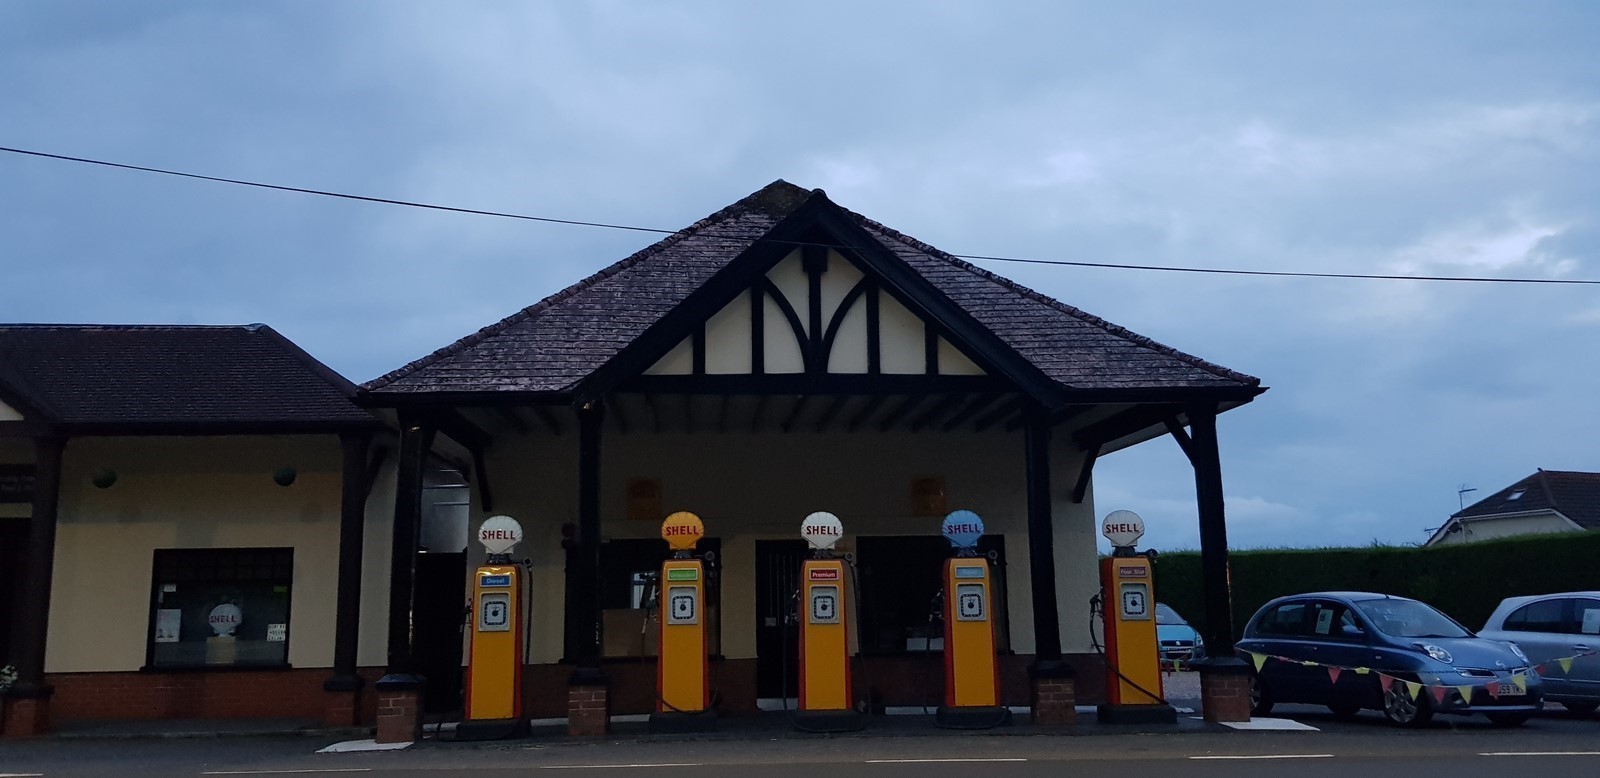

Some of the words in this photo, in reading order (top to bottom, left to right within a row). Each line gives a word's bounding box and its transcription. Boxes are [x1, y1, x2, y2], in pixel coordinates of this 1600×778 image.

[665, 525, 699, 536] SHELL
[806, 525, 839, 535] SHELL
[947, 523, 981, 535] SHELL
[1105, 523, 1139, 534] SHELL
[481, 530, 516, 540] SHELL
[209, 615, 236, 623] SHELL
